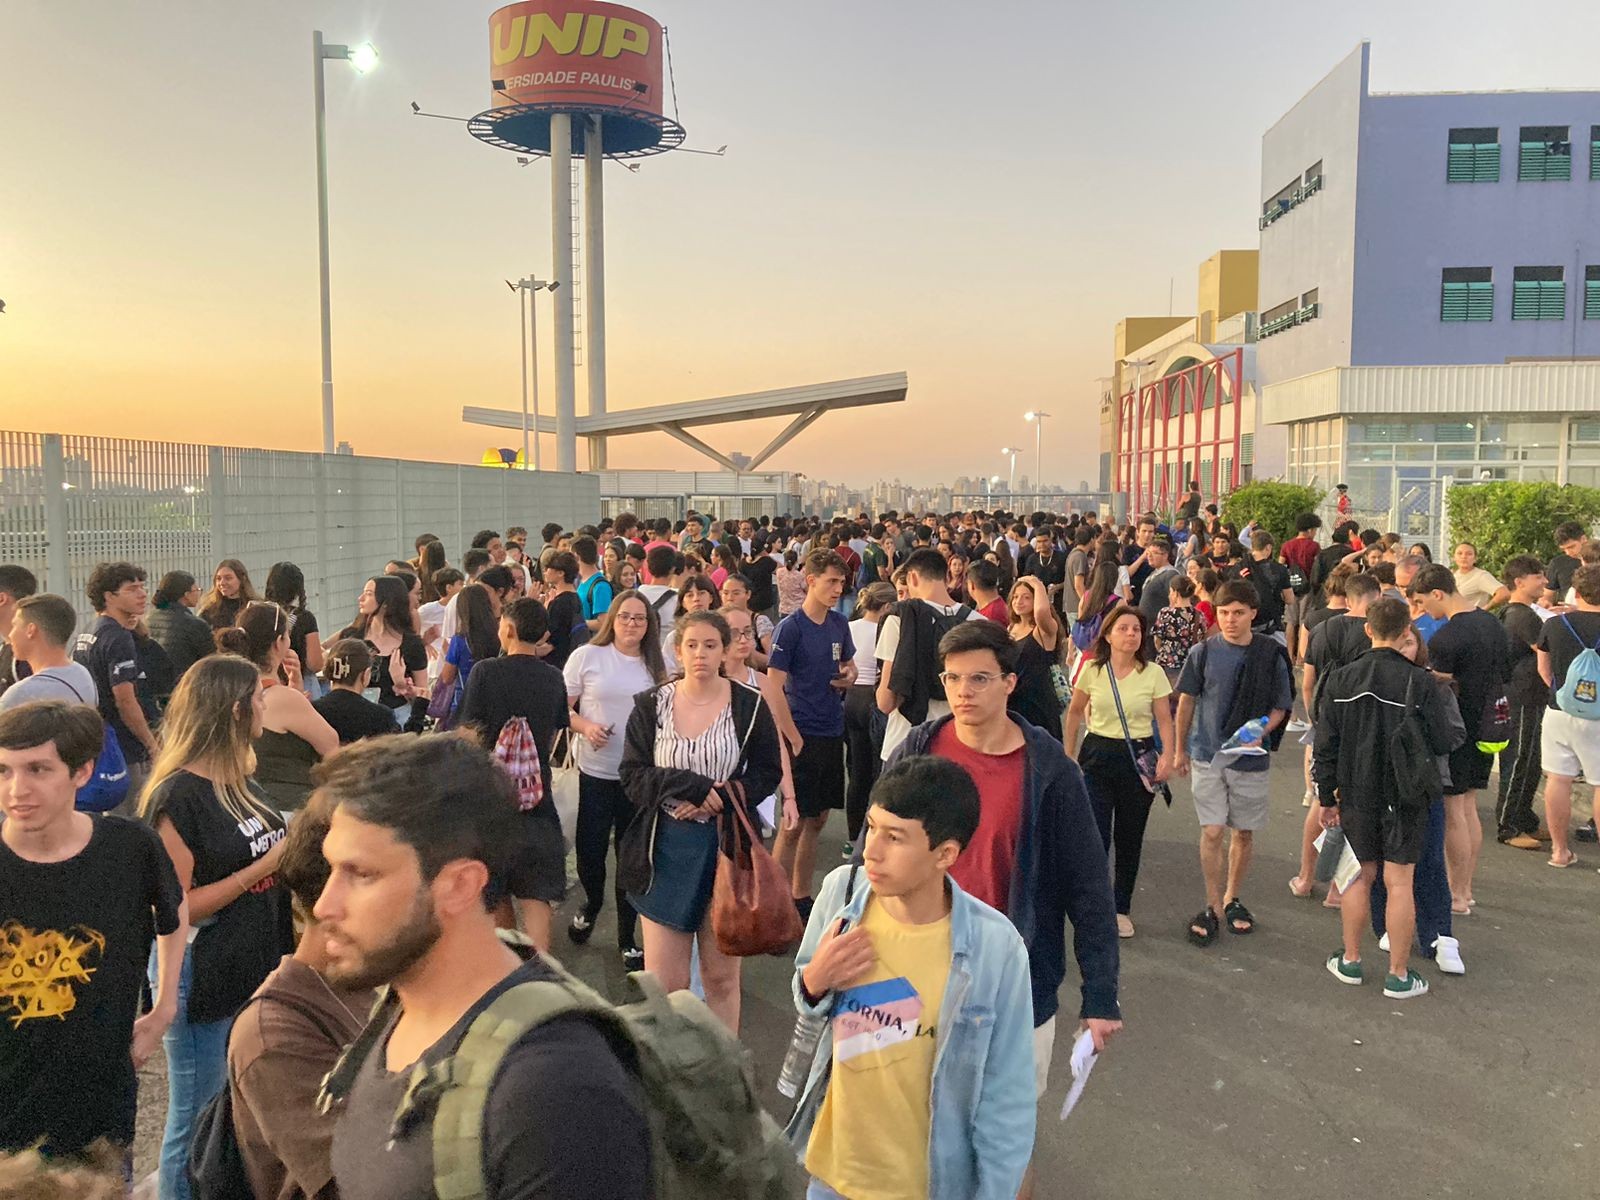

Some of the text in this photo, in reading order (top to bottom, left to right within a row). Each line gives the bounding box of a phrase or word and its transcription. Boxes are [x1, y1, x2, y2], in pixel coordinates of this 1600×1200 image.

[493, 12, 650, 66] UNIP
[505, 71, 637, 91] ERSIDADE PAULIS
[843, 998, 907, 1036] ORNIA,
